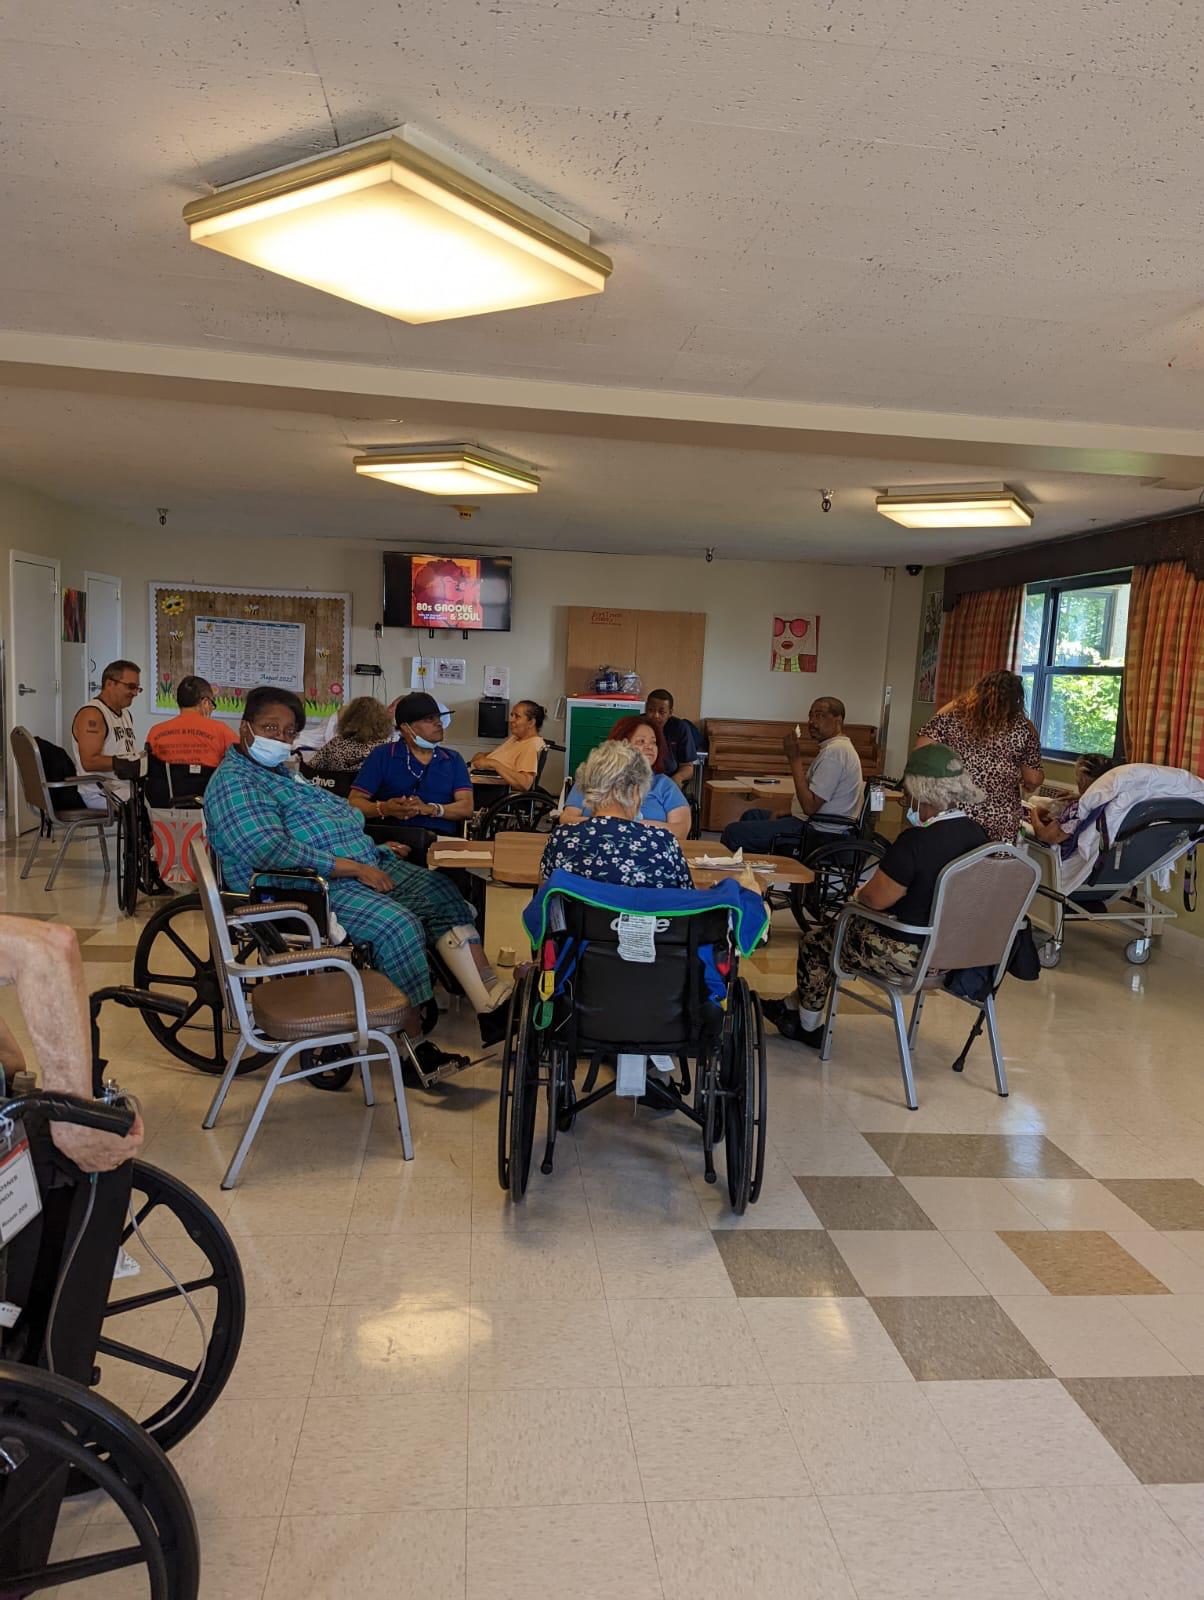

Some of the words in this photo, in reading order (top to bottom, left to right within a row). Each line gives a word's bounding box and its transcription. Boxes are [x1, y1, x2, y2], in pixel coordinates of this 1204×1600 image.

[416, 603, 432, 612] 80s
[434, 603, 473, 613] GROOVE
[449, 613, 456, 621] &
[457, 613, 481, 621] SOUL
[312, 775, 336, 788] drive
